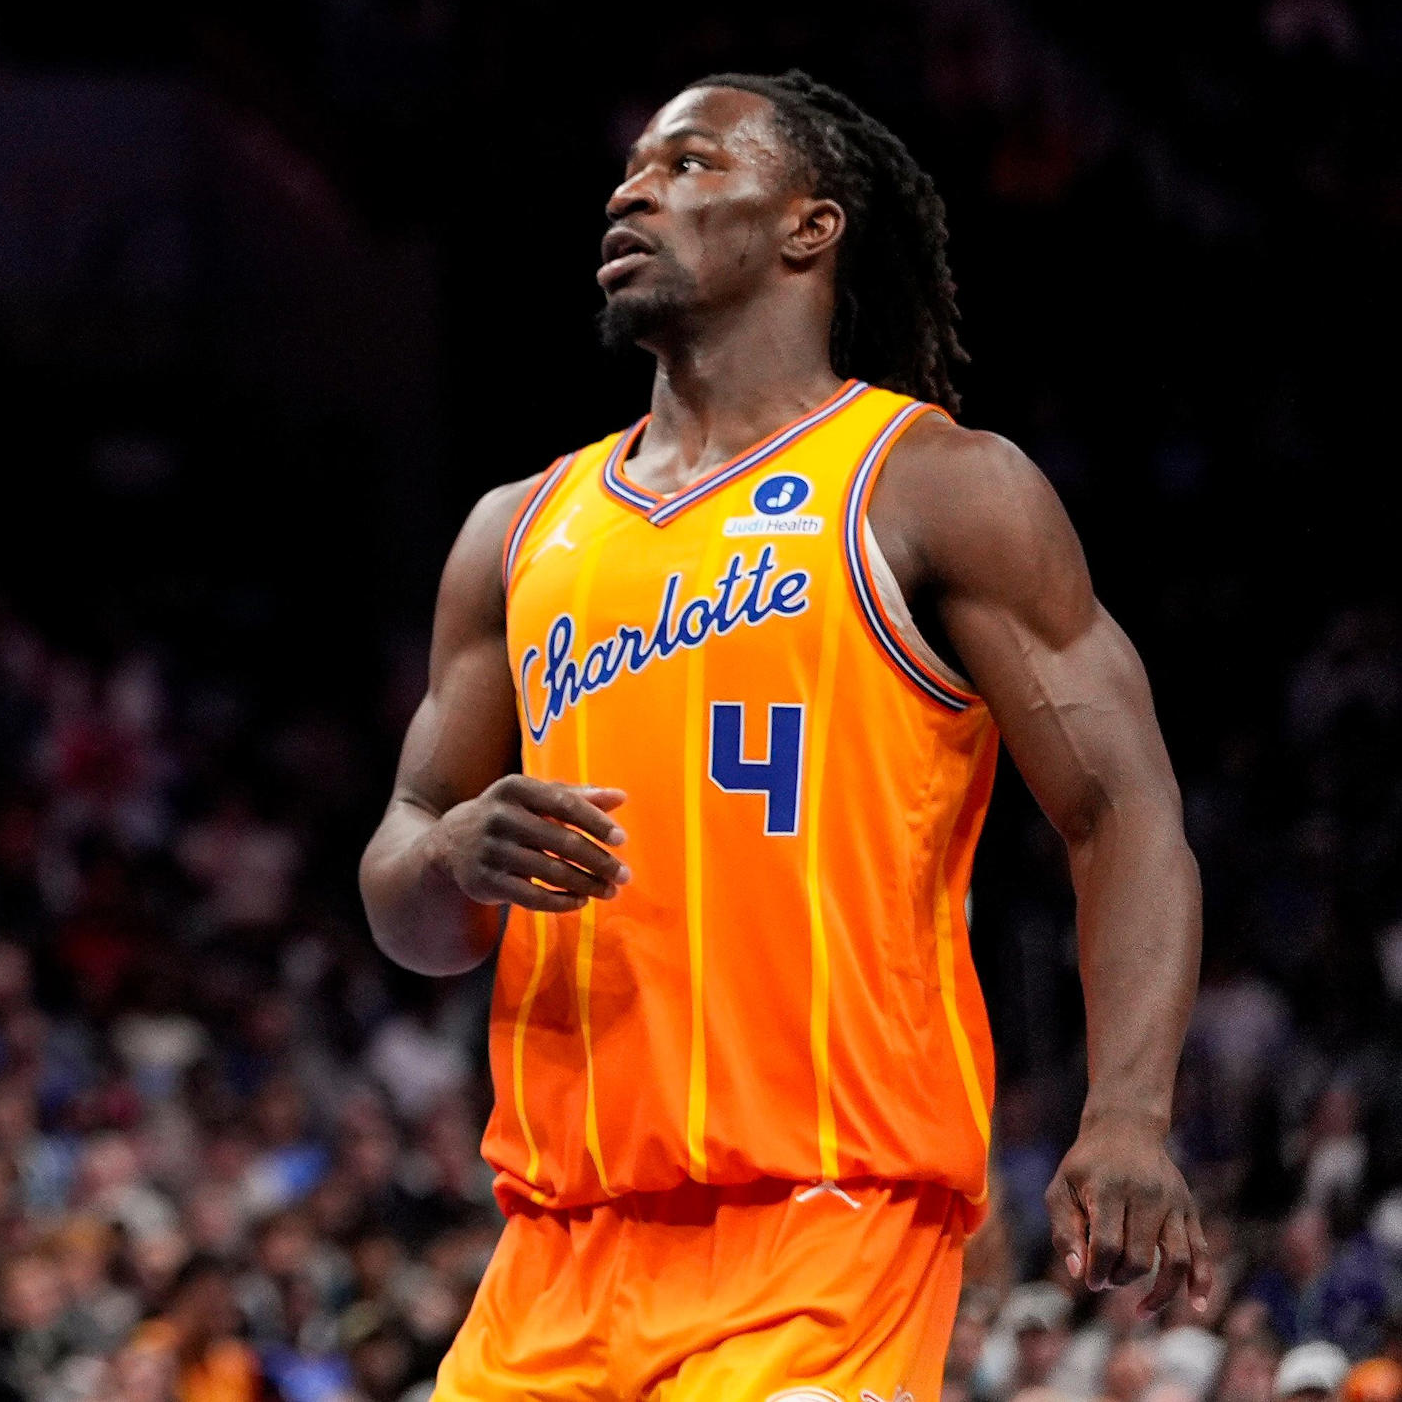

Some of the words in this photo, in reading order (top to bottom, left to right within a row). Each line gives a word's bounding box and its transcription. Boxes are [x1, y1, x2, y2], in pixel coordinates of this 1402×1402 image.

[766, 516, 818, 533] Health
[521, 543, 811, 746] Charlotte
[707, 700, 807, 838] 4
